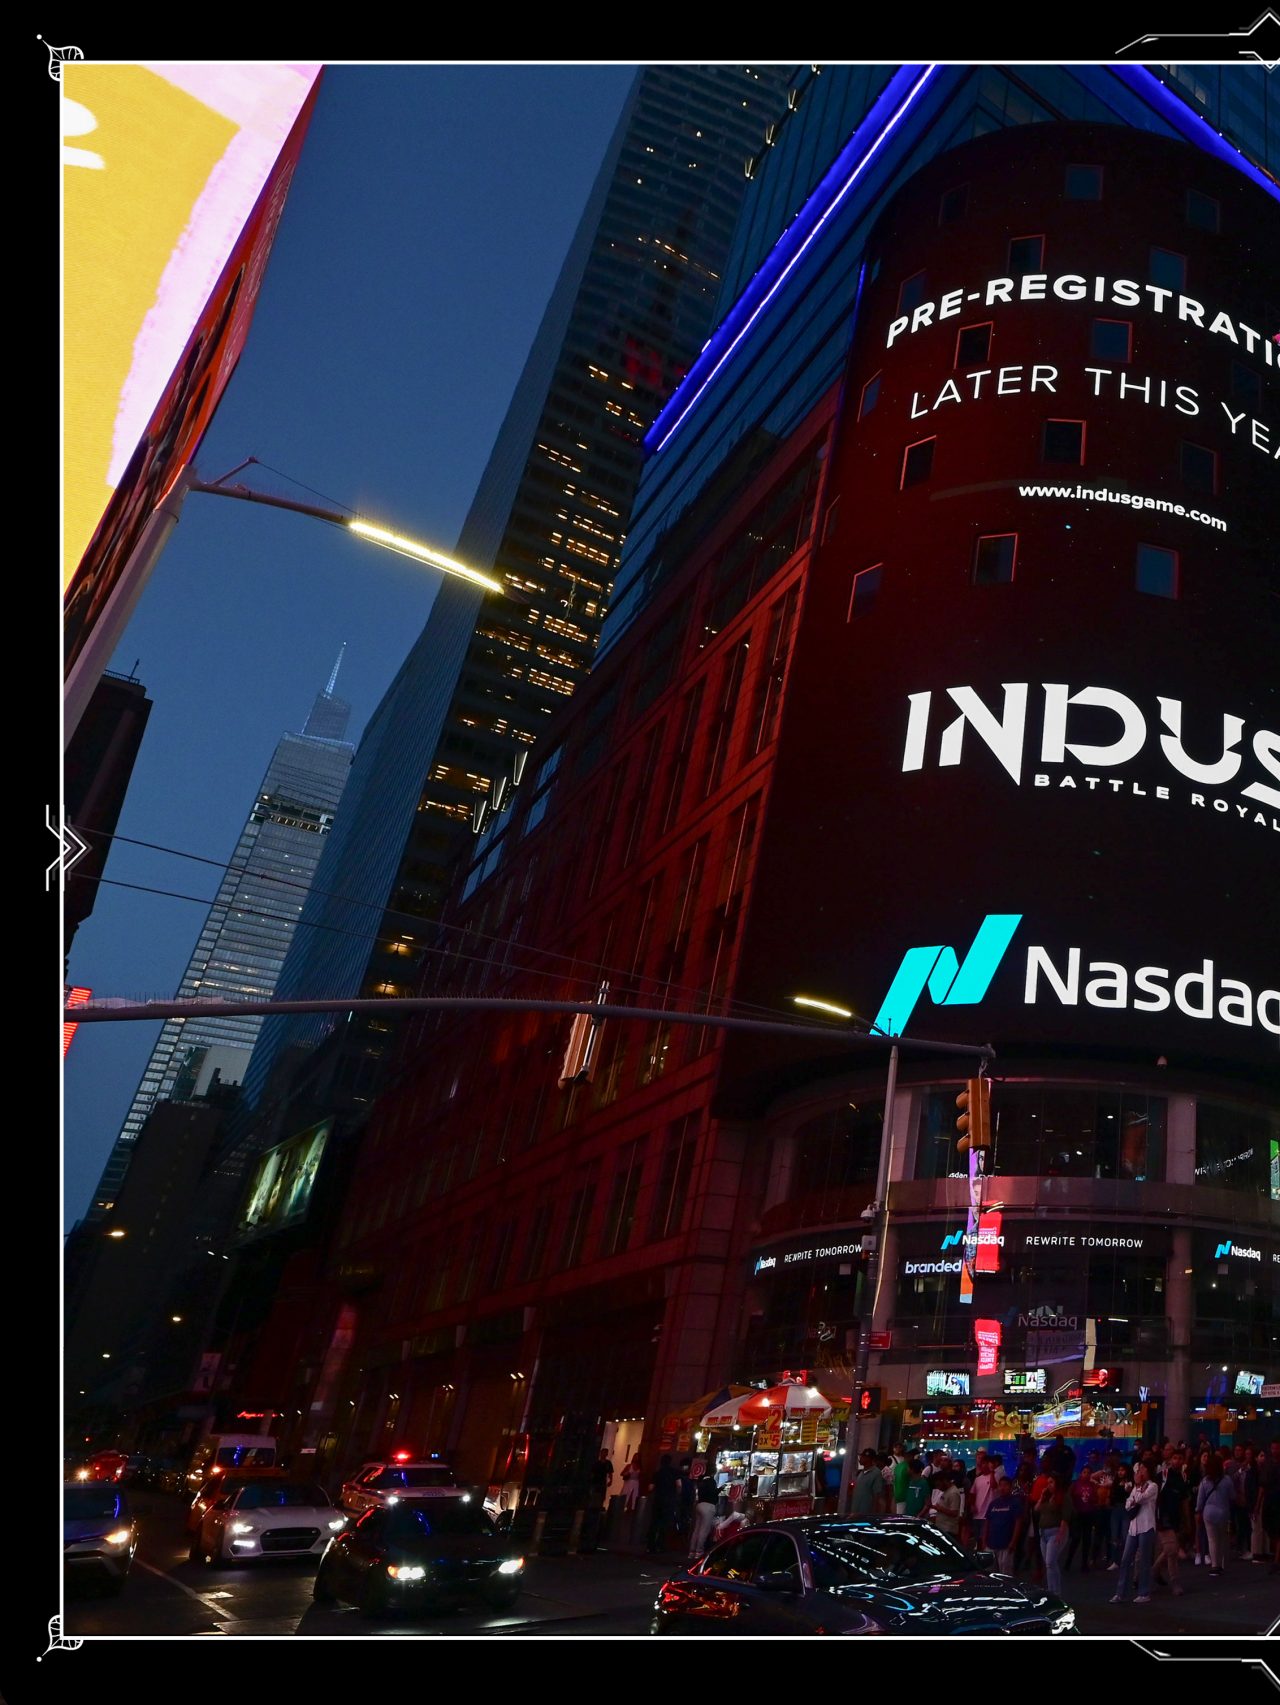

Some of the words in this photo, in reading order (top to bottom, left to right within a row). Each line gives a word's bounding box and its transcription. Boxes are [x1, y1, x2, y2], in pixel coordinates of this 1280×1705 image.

[911, 364, 1058, 420] LATER
[1084, 367, 1200, 416] THIS
[1018, 483, 1228, 532] www.indusgame.com
[1033, 773, 1170, 800] BATTLE
[962, 1234, 1005, 1247] Nasdaq
[1025, 1236, 1076, 1246] REWRITE
[1080, 1236, 1143, 1249] TOMORROW
[784, 1249, 812, 1263] REWRITE
[815, 1244, 863, 1258] TOMORROW
[1231, 1245, 1262, 1262] Nasdaq
[904, 1259, 963, 1274] branded
[1018, 1313, 1078, 1331] Nasdaq
